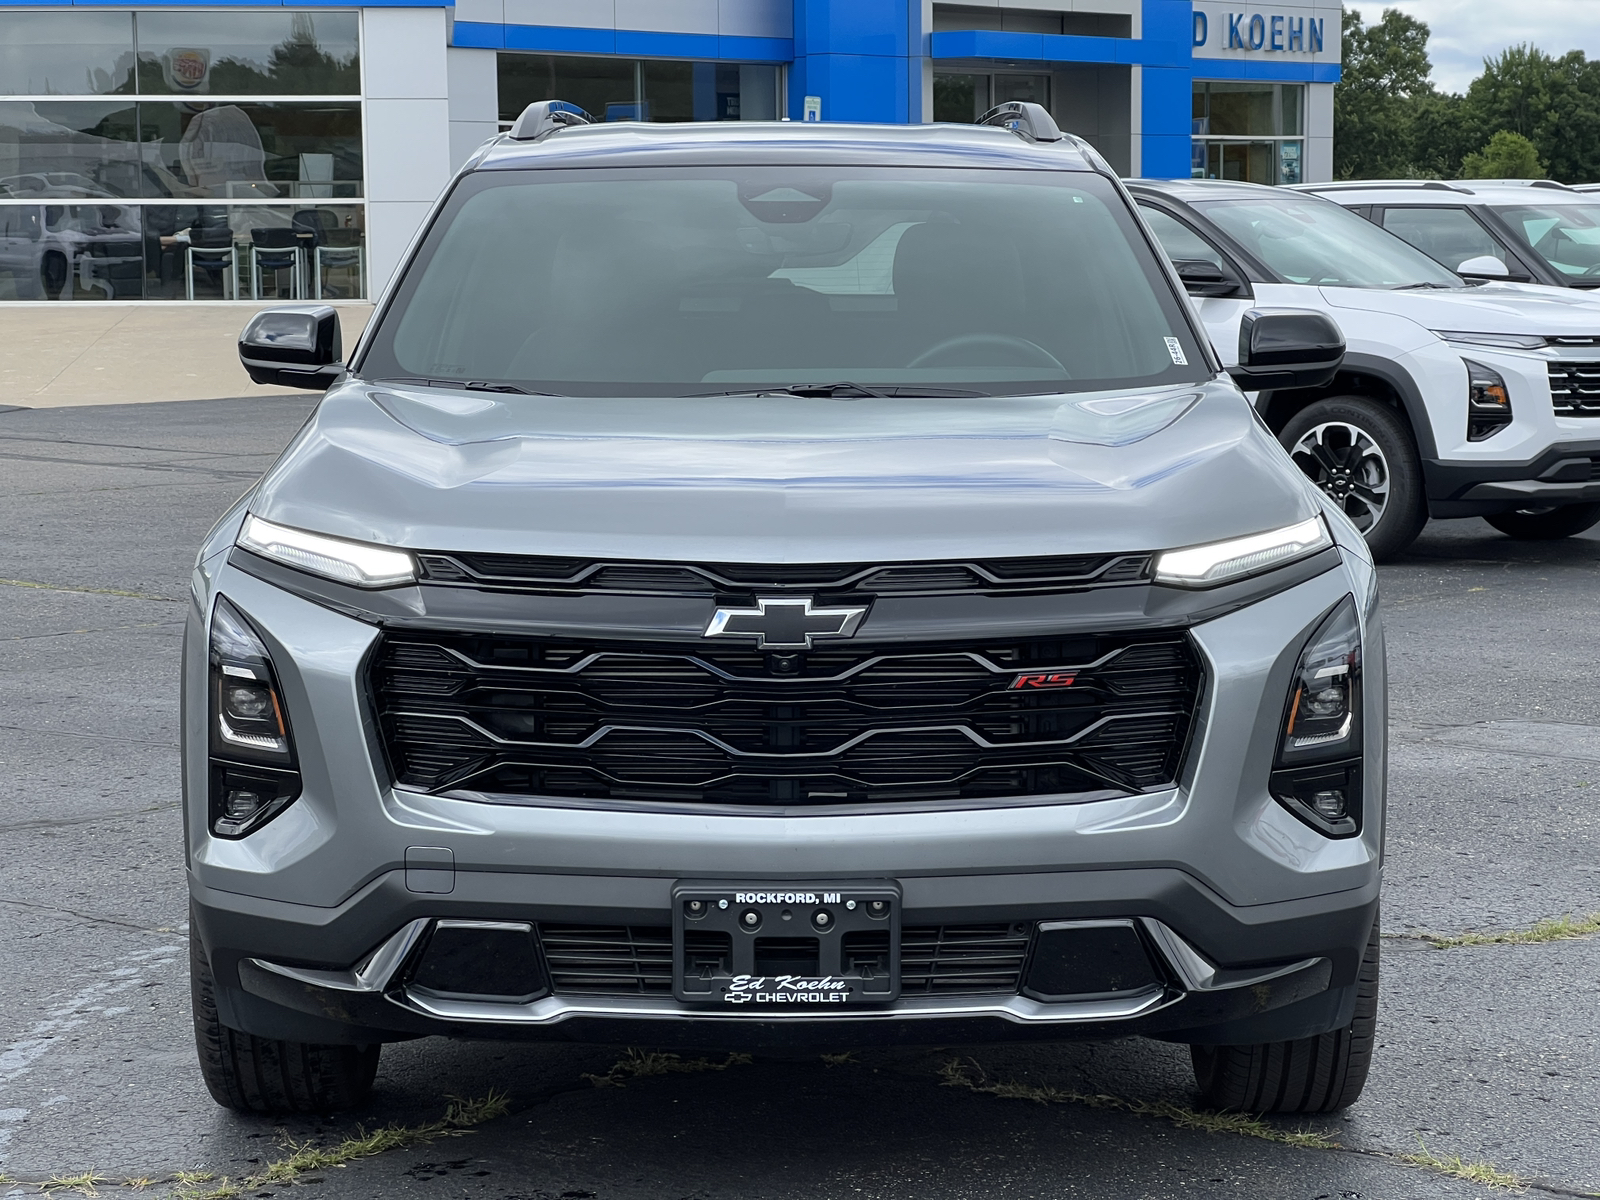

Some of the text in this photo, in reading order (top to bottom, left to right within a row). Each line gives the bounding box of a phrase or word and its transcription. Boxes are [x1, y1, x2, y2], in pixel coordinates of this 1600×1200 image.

[1228, 13, 1324, 52] KOEHN
[1011, 672, 1078, 688] RS
[735, 893, 841, 905] ROCKFORD, MI
[729, 975, 846, 991] Ed Koehn
[756, 992, 850, 1002] CHEVROLET
